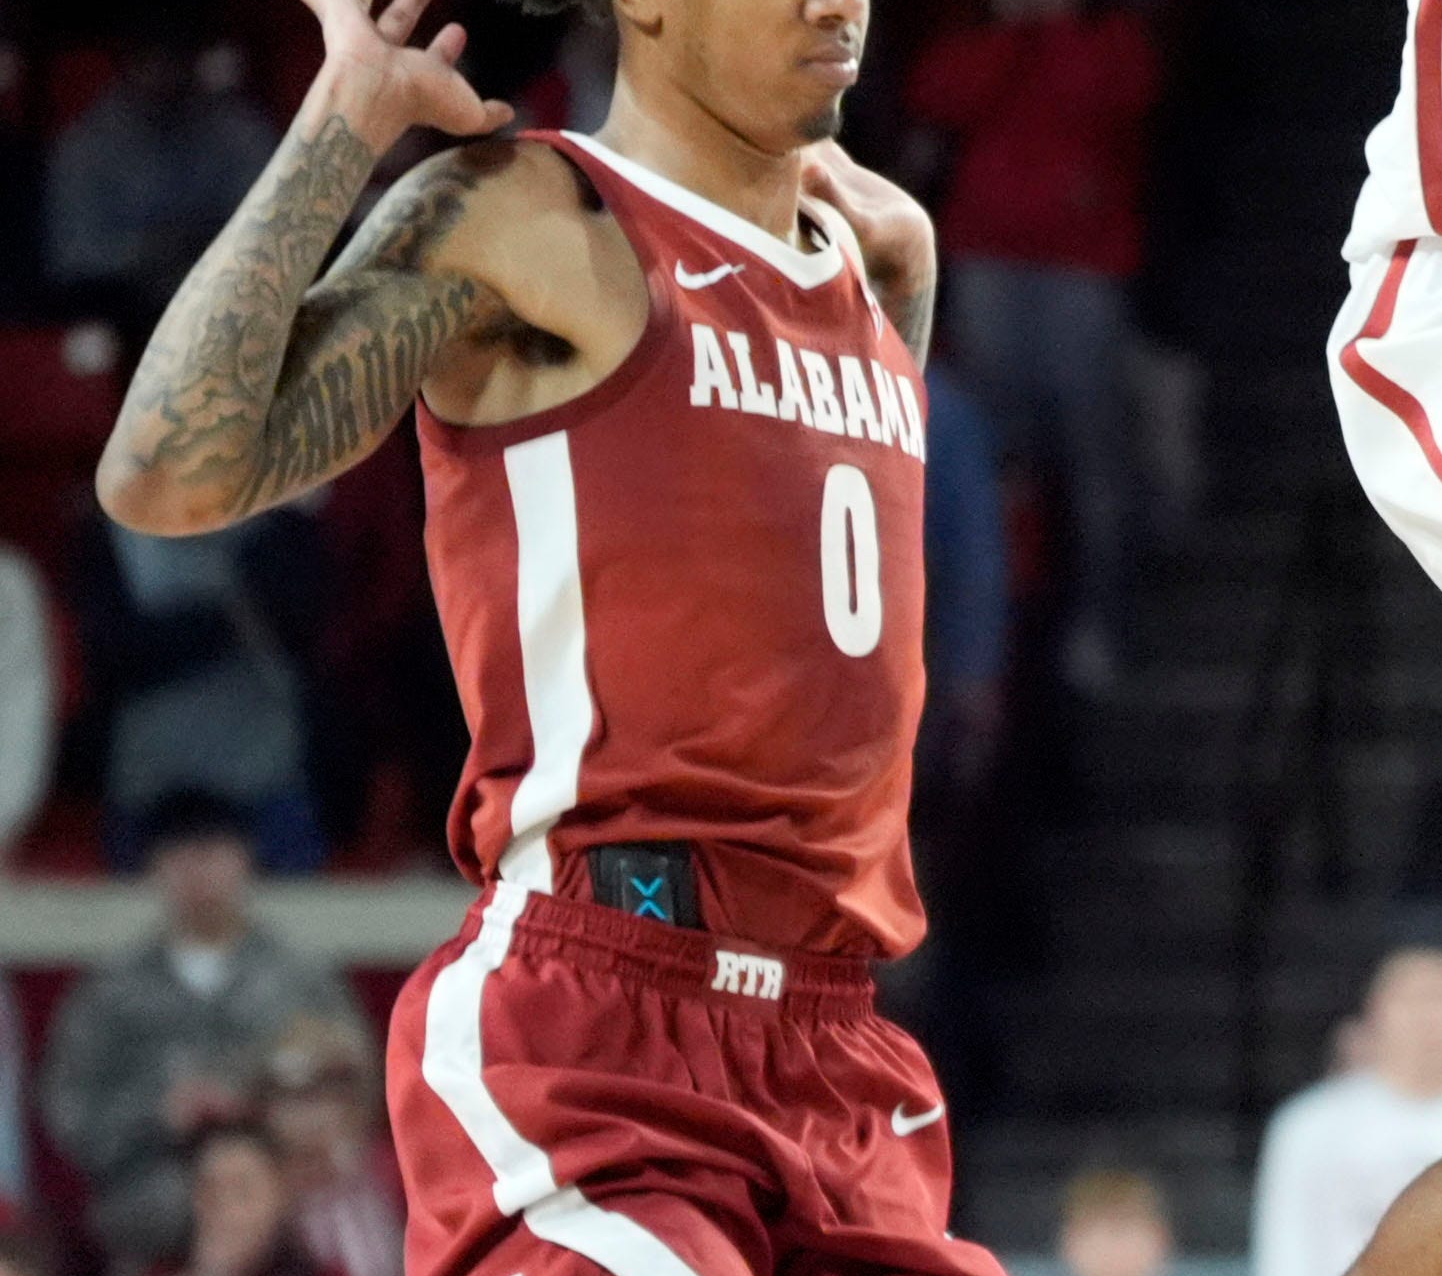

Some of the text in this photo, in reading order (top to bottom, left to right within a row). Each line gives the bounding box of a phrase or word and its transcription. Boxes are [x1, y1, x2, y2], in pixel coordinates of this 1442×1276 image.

[689, 322, 926, 465] ALABAMA
[819, 462, 883, 658] 0
[711, 949, 784, 1001] RTR
